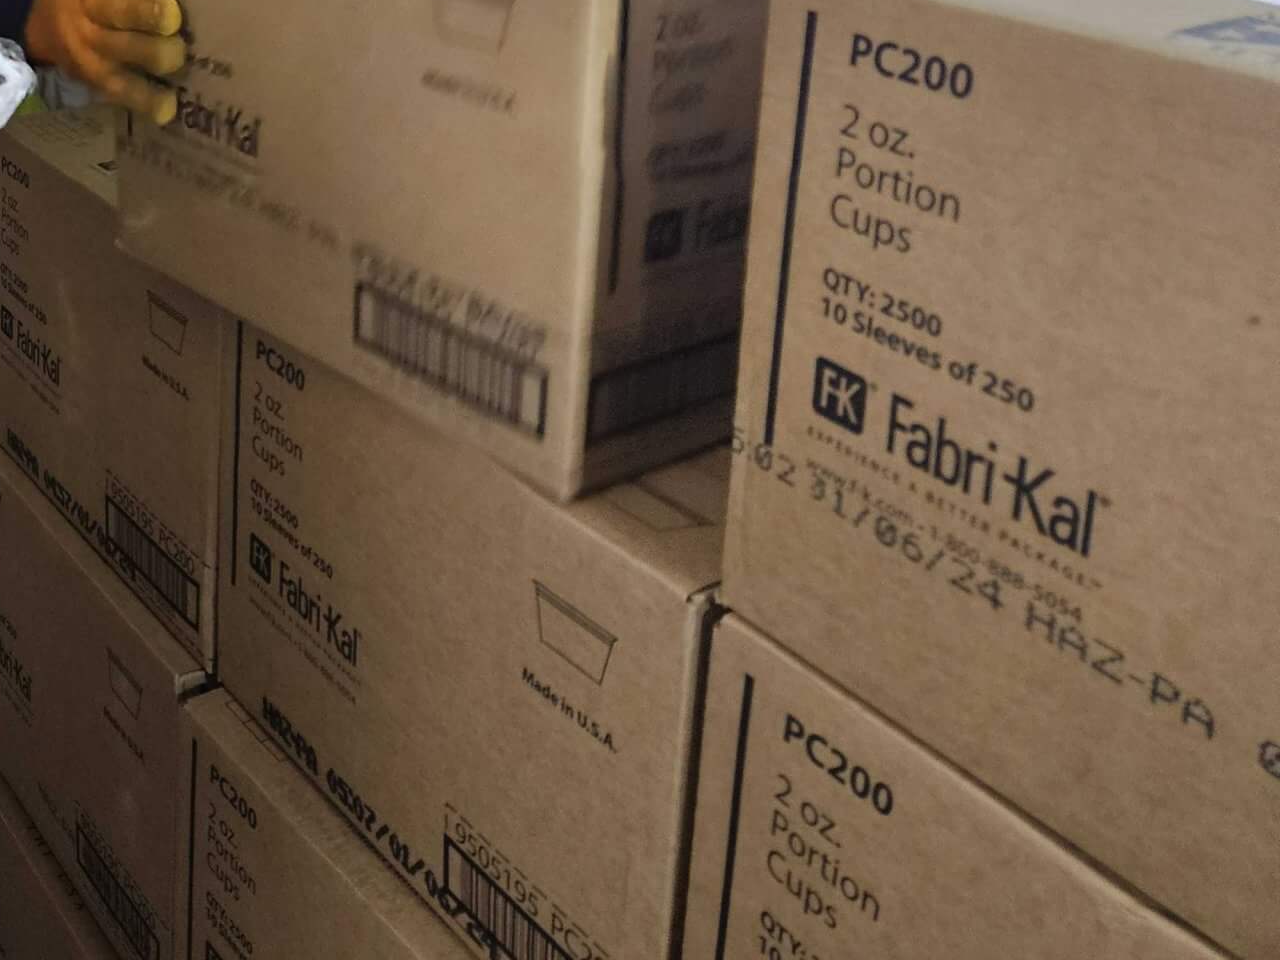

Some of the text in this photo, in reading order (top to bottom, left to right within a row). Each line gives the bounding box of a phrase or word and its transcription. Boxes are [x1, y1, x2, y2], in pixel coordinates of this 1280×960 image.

[850, 33, 974, 99] PC200
[840, 105, 915, 159] 2 oz.
[835, 148, 961, 223] Portion
[830, 194, 911, 254] Cups
[823, 268, 942, 337] QTY: 2500
[17, 322, 61, 386] Fabri-Kal
[256, 340, 305, 390] PC200
[821, 297, 1035, 413] 10 Sleeves of 250
[254, 382, 285, 420] 2 oz.
[252, 436, 285, 476] Cups
[253, 406, 303, 463] Portion
[817, 363, 1097, 557] FK Fabri-Kal
[272, 500, 299, 529] 2500
[925, 493, 990, 536] BETTER
[279, 561, 358, 666] Fabri-Kal
[1024, 602, 1216, 740] HAZ-PA
[522, 667, 618, 753] Made in U.S.A.
[210, 764, 257, 829] PC200
[784, 714, 893, 816] PC200
[210, 803, 217, 821] 2
[774, 774, 842, 849] 2 oz.
[207, 852, 240, 901] Cups
[208, 825, 256, 895] Portion
[454, 821, 540, 918] 9505195
[767, 850, 837, 930] Cups
[771, 810, 880, 923] Portion
[760, 911, 808, 956] QTY:
